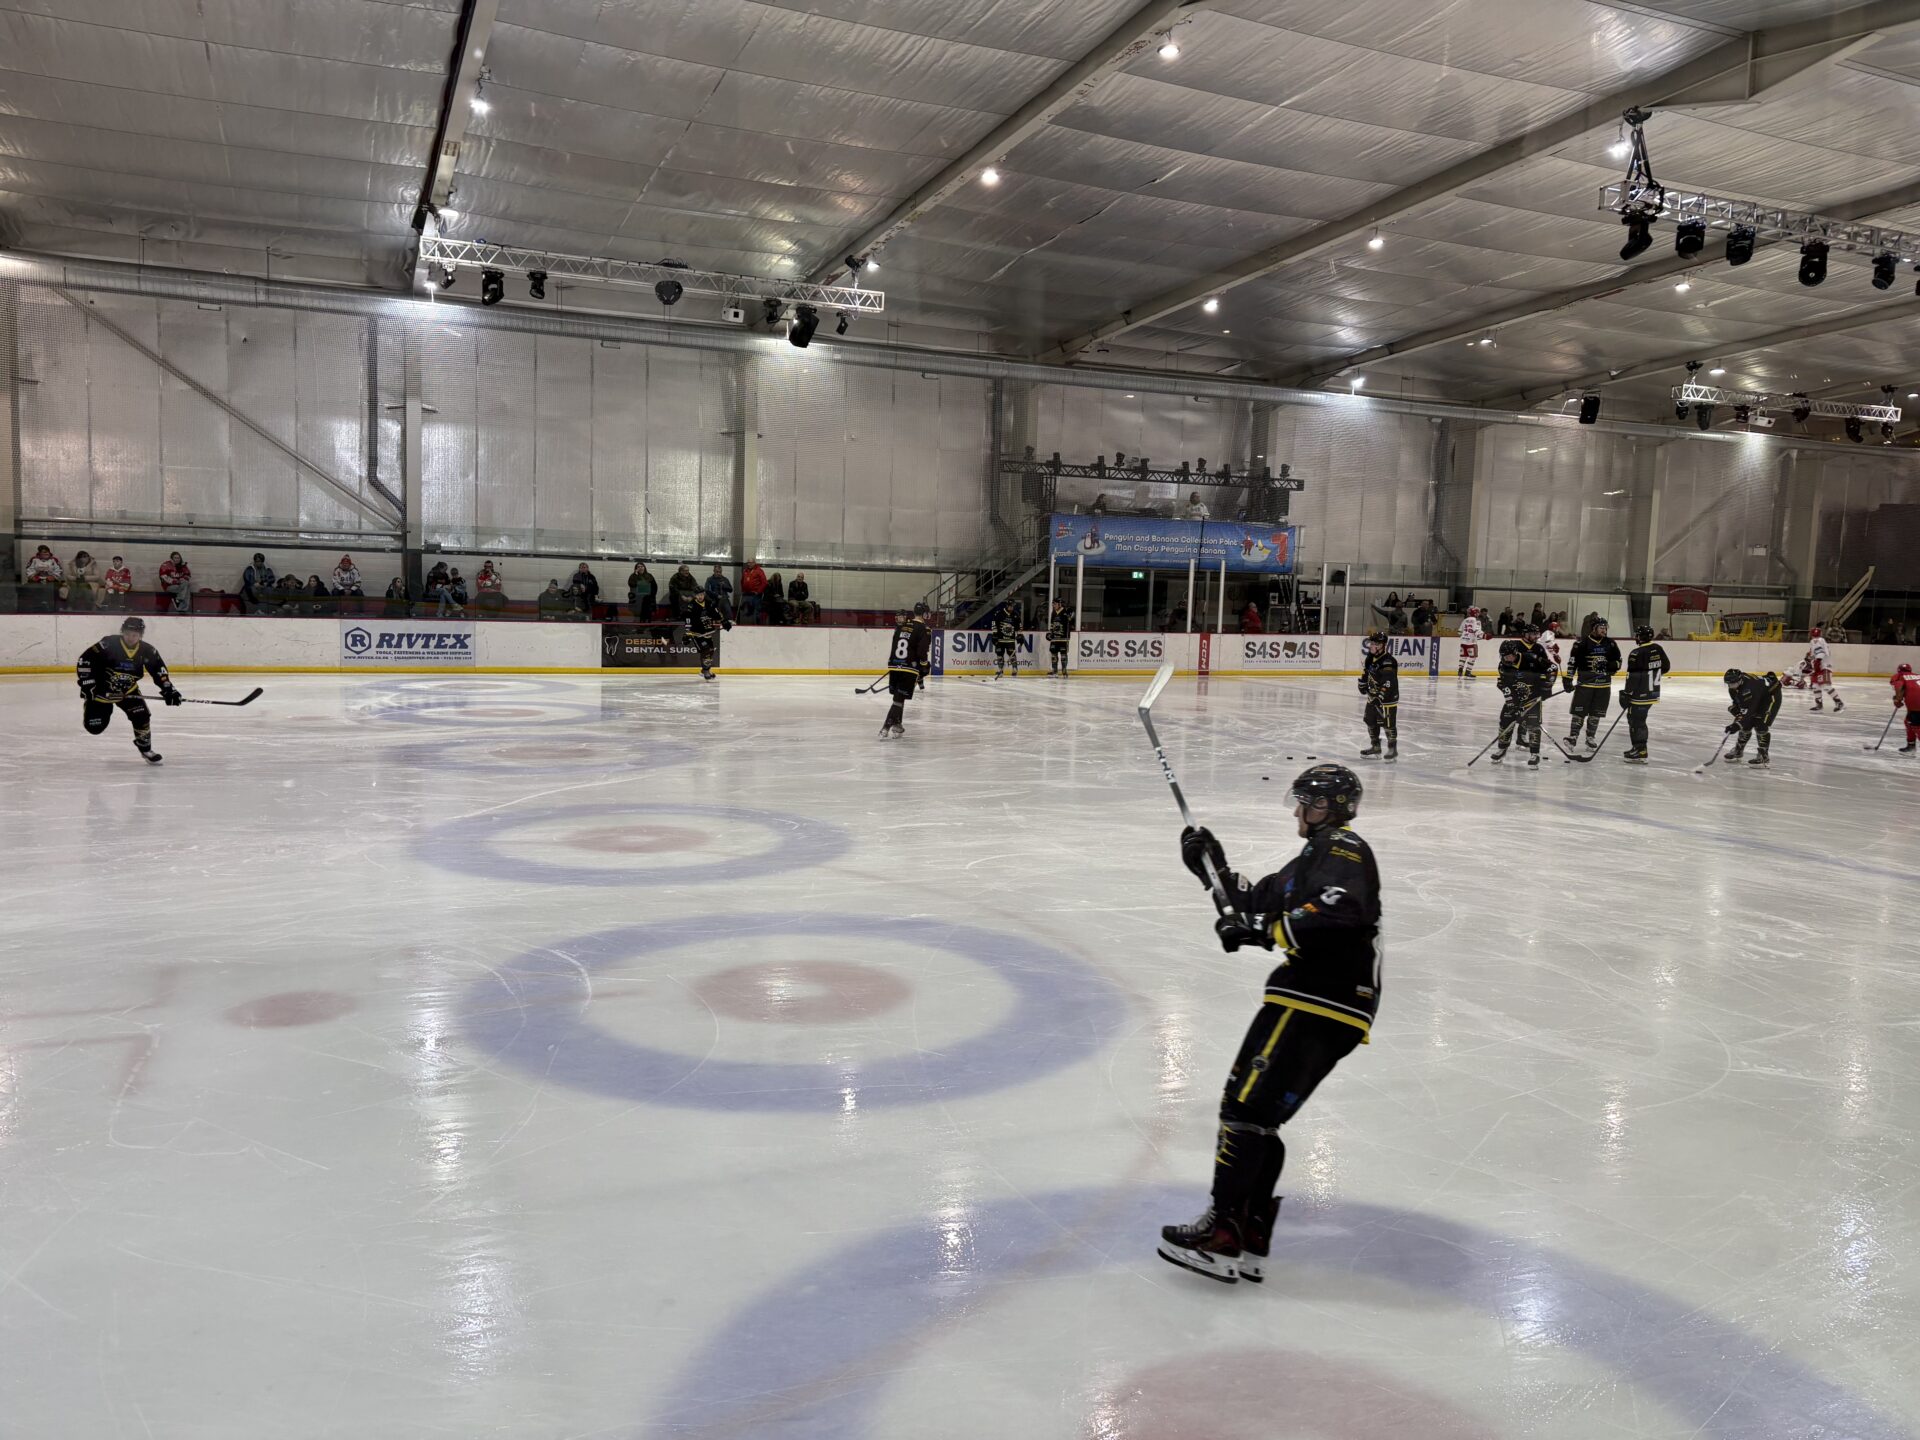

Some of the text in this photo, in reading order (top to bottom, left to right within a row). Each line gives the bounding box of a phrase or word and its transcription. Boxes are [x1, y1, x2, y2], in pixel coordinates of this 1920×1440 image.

[1104, 533, 1134, 543] Penguin
[1135, 534, 1150, 542] and
[1151, 535, 1179, 543] Banana
[1115, 543, 1132, 551] Man
[350, 634, 367, 648] R
[375, 632, 472, 649] RIVTEX
[895, 638, 909, 660] 8
[951, 632, 1033, 653] SIMN
[1080, 639, 1164, 658] S4S S4S
[625, 646, 667, 654] DENTAL
[934, 635, 942, 669] CCM
[1200, 639, 1209, 670] CCM
[1244, 641, 1281, 659] S4S
[969, 658, 992, 667] safety.
[1647, 668, 1662, 691] 14
